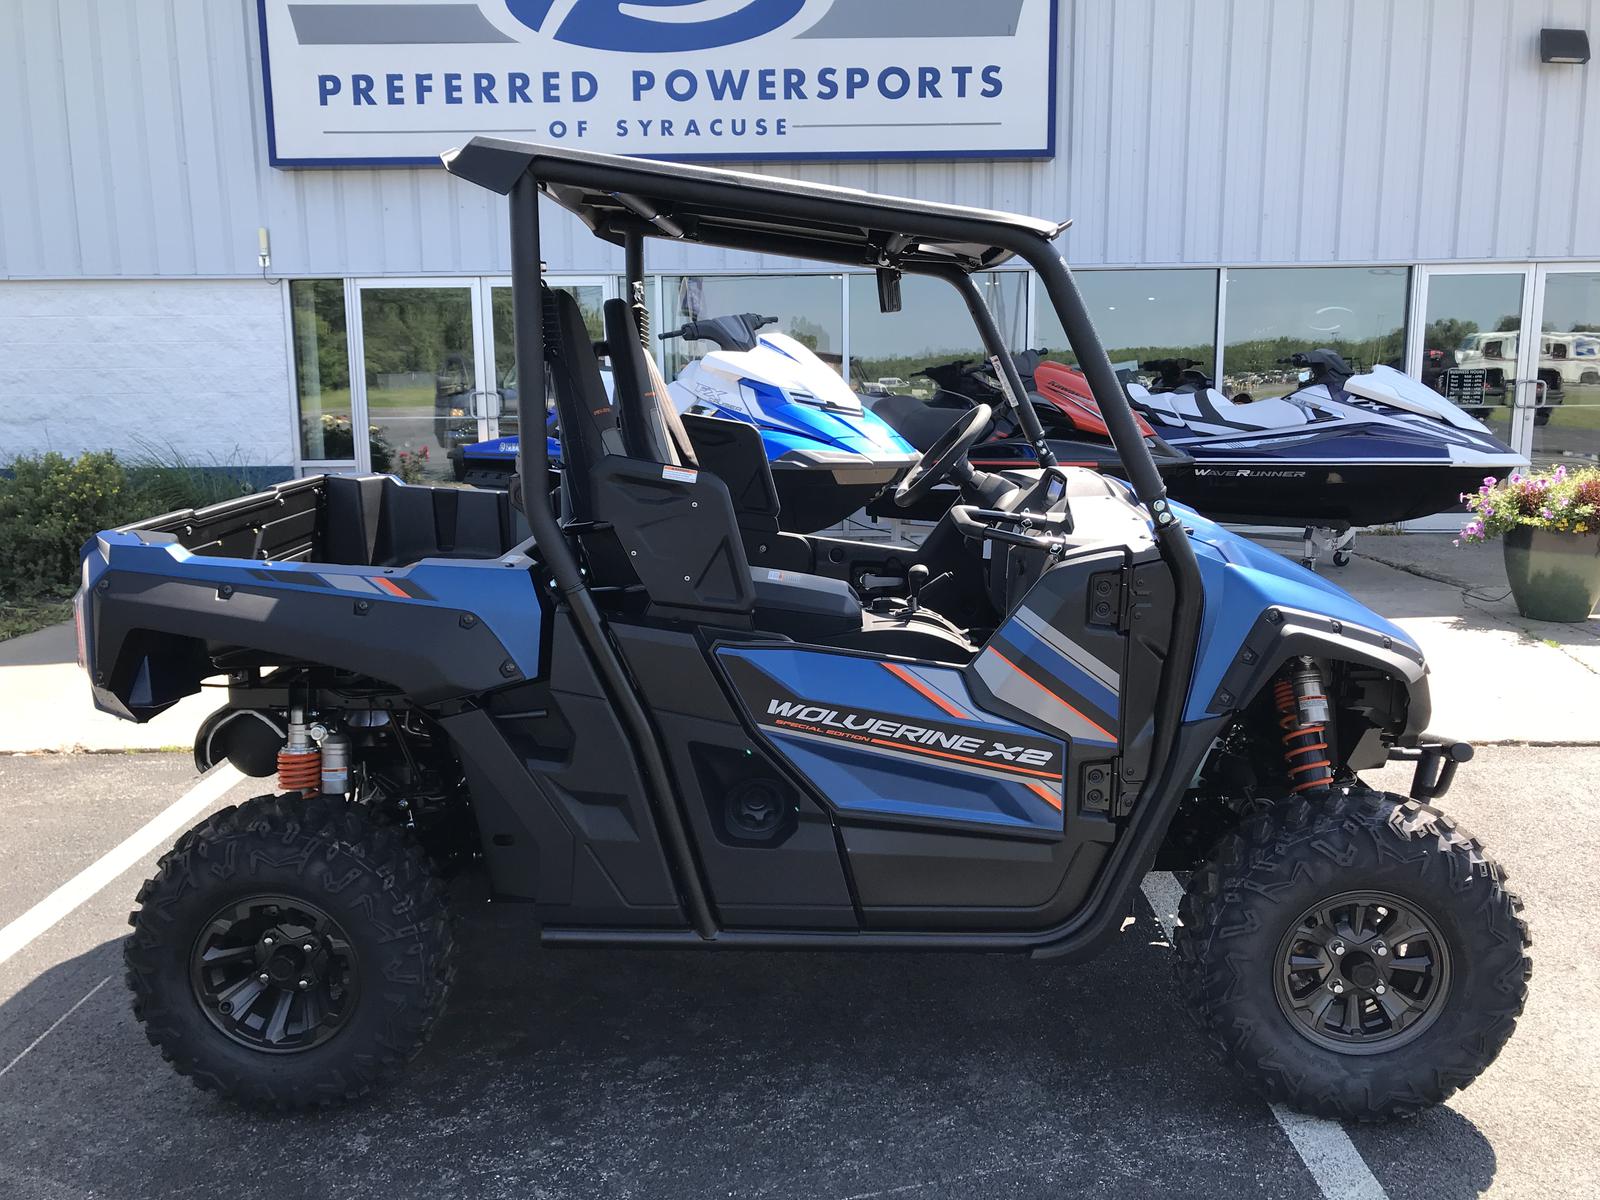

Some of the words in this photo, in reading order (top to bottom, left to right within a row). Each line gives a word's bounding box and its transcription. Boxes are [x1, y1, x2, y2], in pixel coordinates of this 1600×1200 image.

[319, 70, 598, 106] PREFERRED
[632, 65, 1003, 102] POWERSPORTS
[548, 120, 587, 139] OF
[616, 118, 785, 137] SYRACUSE
[767, 699, 986, 754] WOLVERINE
[984, 742, 1054, 766] X2
[775, 719, 824, 733] SPECIAL
[825, 729, 870, 742] EDITION
